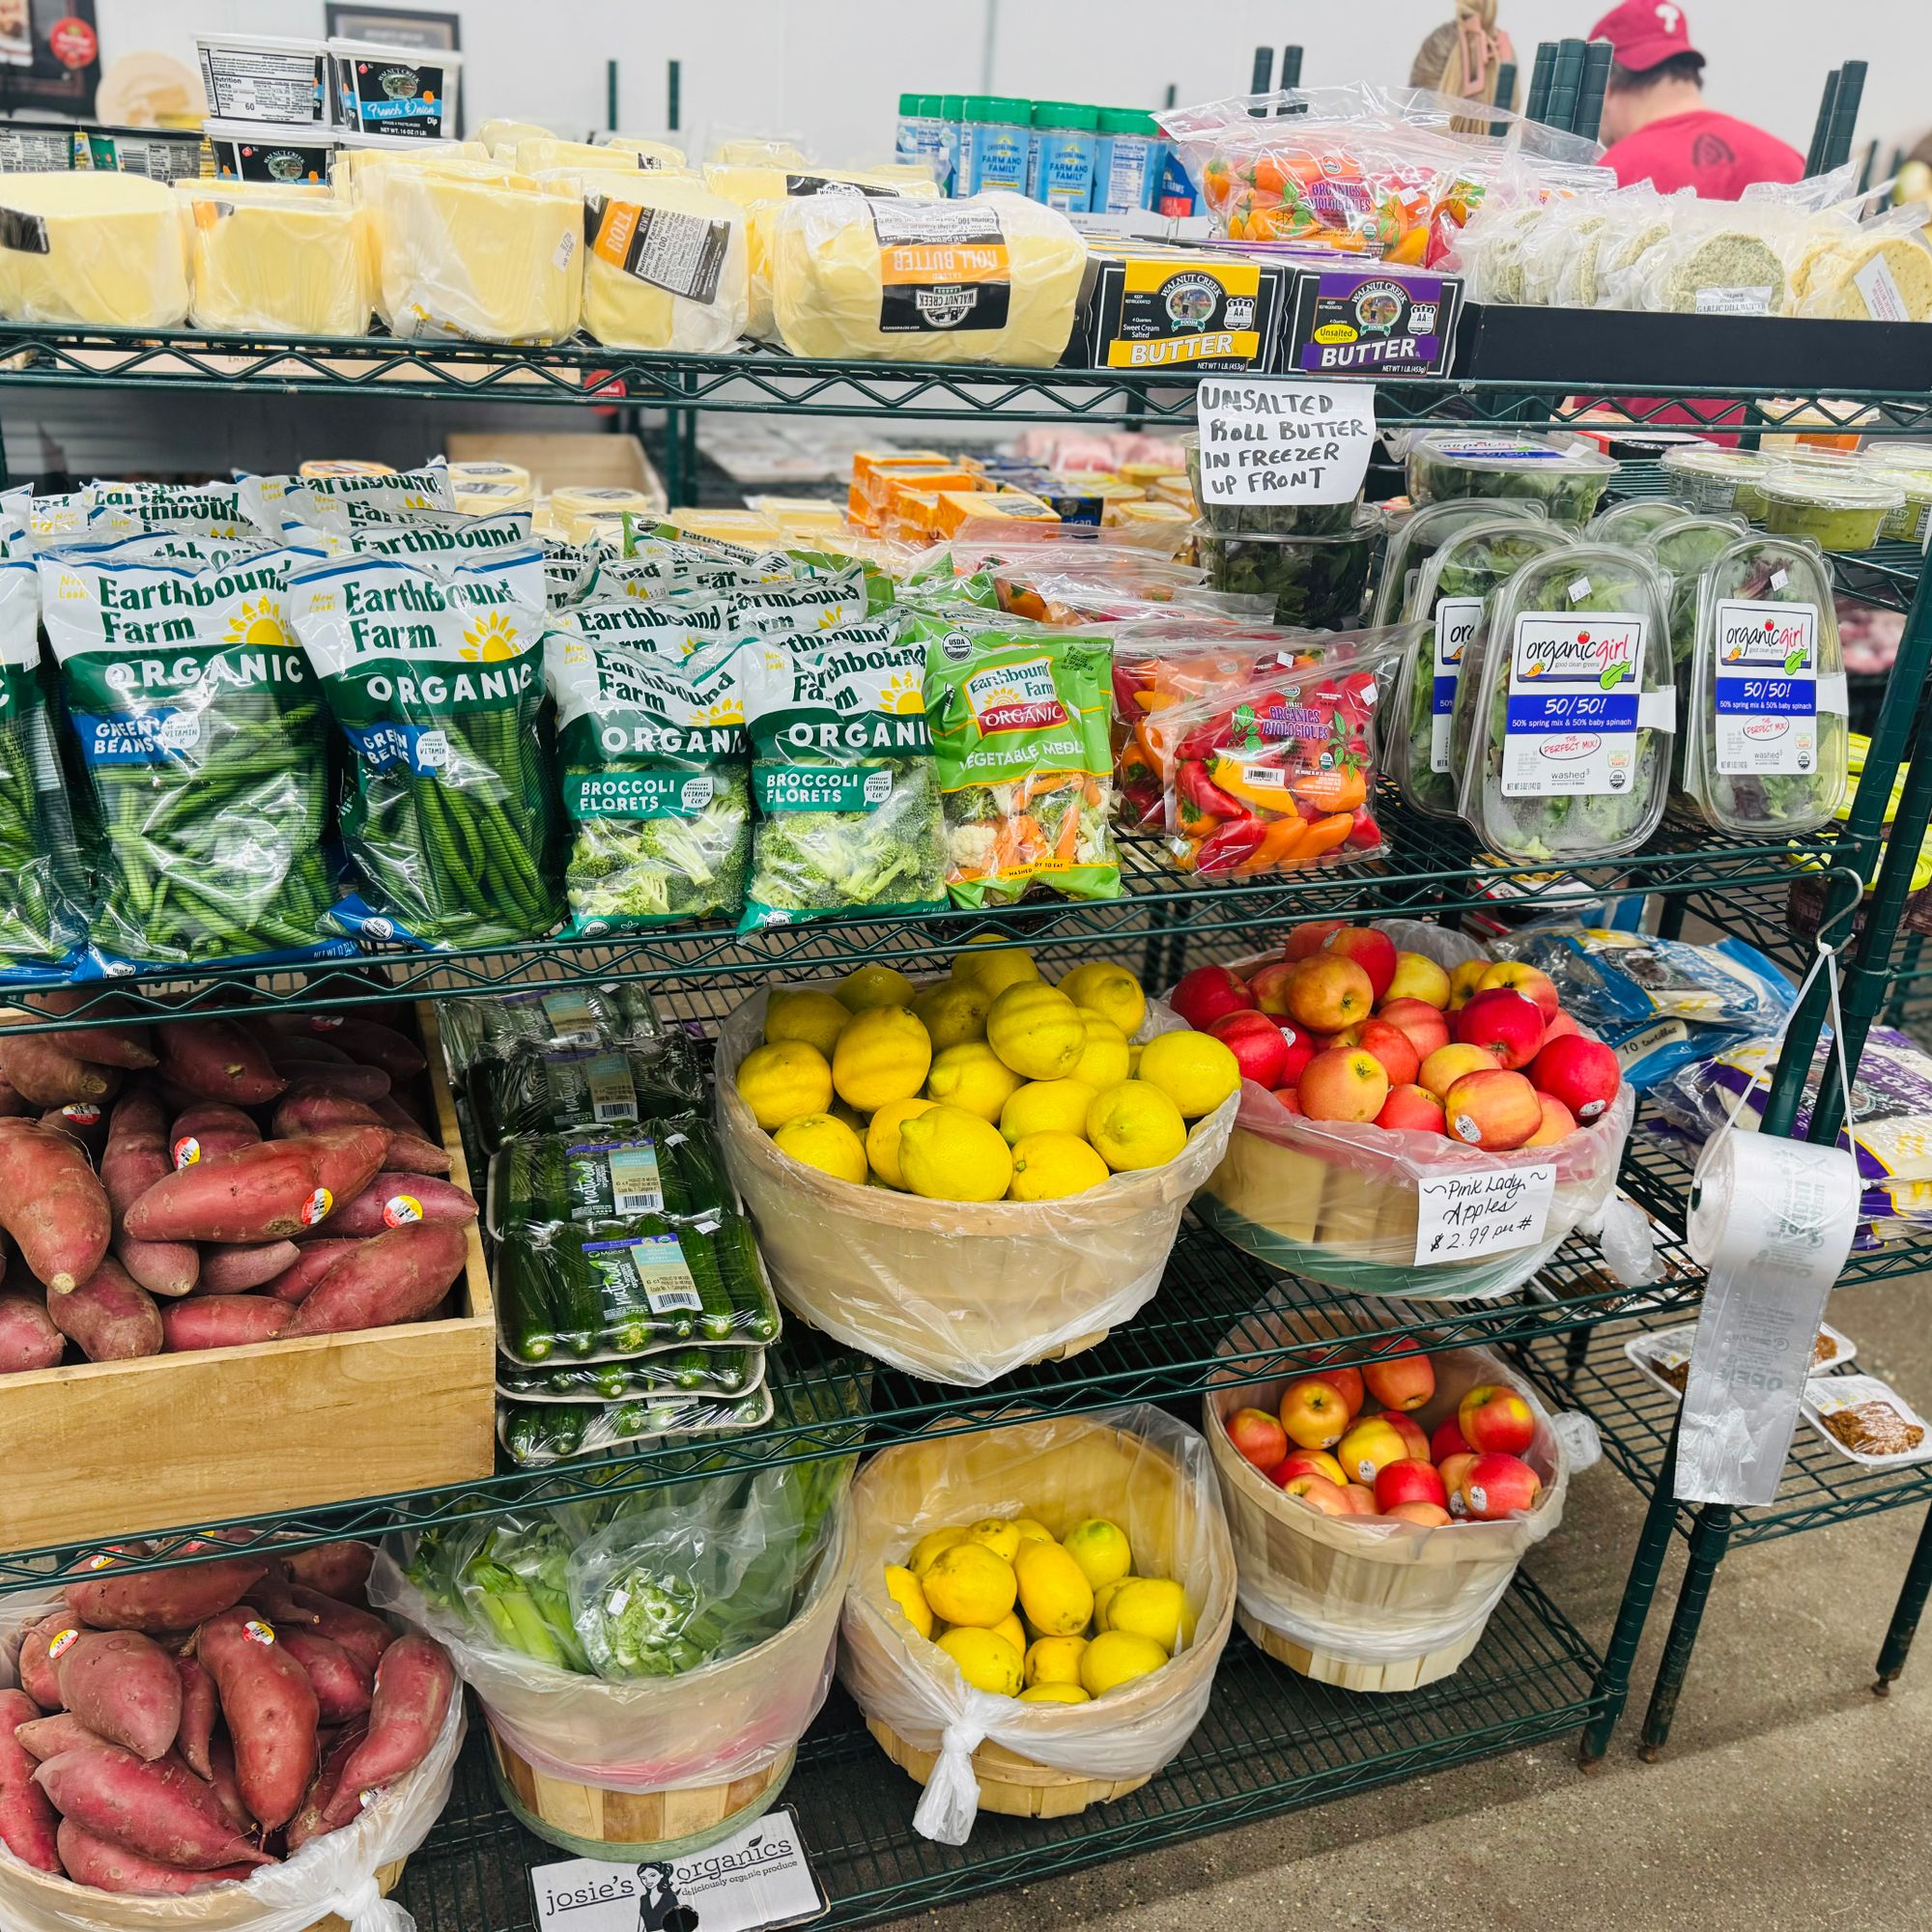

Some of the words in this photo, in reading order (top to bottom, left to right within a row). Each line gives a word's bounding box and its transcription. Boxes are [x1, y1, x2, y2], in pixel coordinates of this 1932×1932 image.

[244, 102, 255, 111] 60
[367, 103, 403, 118] French
[405, 101, 436, 116] Onion
[426, 116, 438, 126] Dip
[981, 155, 1006, 164] FARM
[1007, 156, 1021, 166] AND
[988, 164, 1016, 173] FAMILY
[1049, 163, 1072, 172] FARM
[1073, 164, 1089, 173] AND
[1056, 172, 1083, 182] FAMILY
[1160, 273, 1197, 298] WALNUT
[1197, 273, 1223, 298] CREEK
[1351, 281, 1385, 303] WALNUT
[1385, 281, 1408, 304] CREEK
[919, 293, 943, 307] CREEK
[942, 291, 976, 306] WALNUT
[1320, 327, 1353, 337] Unsalted
[1130, 334, 1234, 365] BUTTER
[1321, 338, 1416, 367] BUTTER
[1202, 385, 1334, 416] UNSALTED
[1209, 417, 1269, 442] ROLL
[1278, 417, 1369, 441] BUTTER
[1205, 450, 1231, 469] IN
[1237, 440, 1341, 469] FREEZER
[1211, 473, 1237, 497] UP
[1246, 466, 1327, 494] FRONT
[97, 558, 293, 611] Earthbound
[311, 592, 335, 603] New
[342, 578, 523, 618] Earthbound
[308, 603, 337, 614] Look!
[100, 610, 197, 644] Farm
[349, 616, 438, 654] Farm
[564, 642, 584, 654] New
[1725, 621, 1806, 658] organicgirl
[1526, 633, 1630, 672] organicgirl
[104, 653, 304, 691] ORGANIC
[366, 663, 533, 704] ORGANIC
[595, 671, 668, 715] Farm
[1743, 679, 1792, 698] 50/50!
[1268, 705, 1321, 724] ORGANICS
[1544, 696, 1608, 717] 50/50!
[1732, 700, 1749, 710] spring
[1766, 701, 1777, 710] 50%
[1792, 702, 1812, 711] spinach
[984, 704, 1064, 727] ORGANIC
[1512, 718, 1527, 728] 50%
[1528, 719, 1549, 729] spring
[1551, 719, 1564, 727] mix
[1565, 719, 1572, 727] &
[1572, 718, 1587, 727] 50%
[1588, 718, 1605, 729] baby
[1606, 718, 1633, 727] spinach
[95, 720, 155, 739] GREEN
[787, 721, 935, 749] ORGANI
[1262, 721, 1331, 741] BIOLOGIQUES
[94, 736, 156, 755] BEANS
[1544, 740, 1580, 754] PERFECT
[1581, 738, 1599, 750] MIX!
[1753, 750, 1780, 760] washed
[959, 744, 1039, 772] VEGETABLE
[766, 773, 859, 788] BROCCOLI
[1550, 770, 1585, 781] washed
[581, 779, 674, 797] BROCCOLI
[683, 789, 712, 799] VITAMIN
[766, 788, 842, 804] FLORETS
[865, 783, 892, 792] VITAMIN
[580, 795, 660, 812] FLORETS
[1009, 867, 1034, 877] WASHED
[1621, 1039, 1639, 1055] 10
[1641, 1025, 1678, 1047] tortillas
[572, 1159, 601, 1207] natural
[1447, 1177, 1484, 1200] Pink
[1485, 1173, 1526, 1200] Lady
[1442, 1197, 1519, 1227] Apples
[1492, 1223, 1514, 1239] per
[1517, 1214, 1533, 1231] #
[600, 1247, 626, 1257] Mucci
[545, 1875, 636, 1917] josie's
[676, 1838, 793, 1881] organics
[681, 1878, 727, 1897] deliciously
[729, 1868, 761, 1885] organic
[762, 1860, 799, 1876] produce
